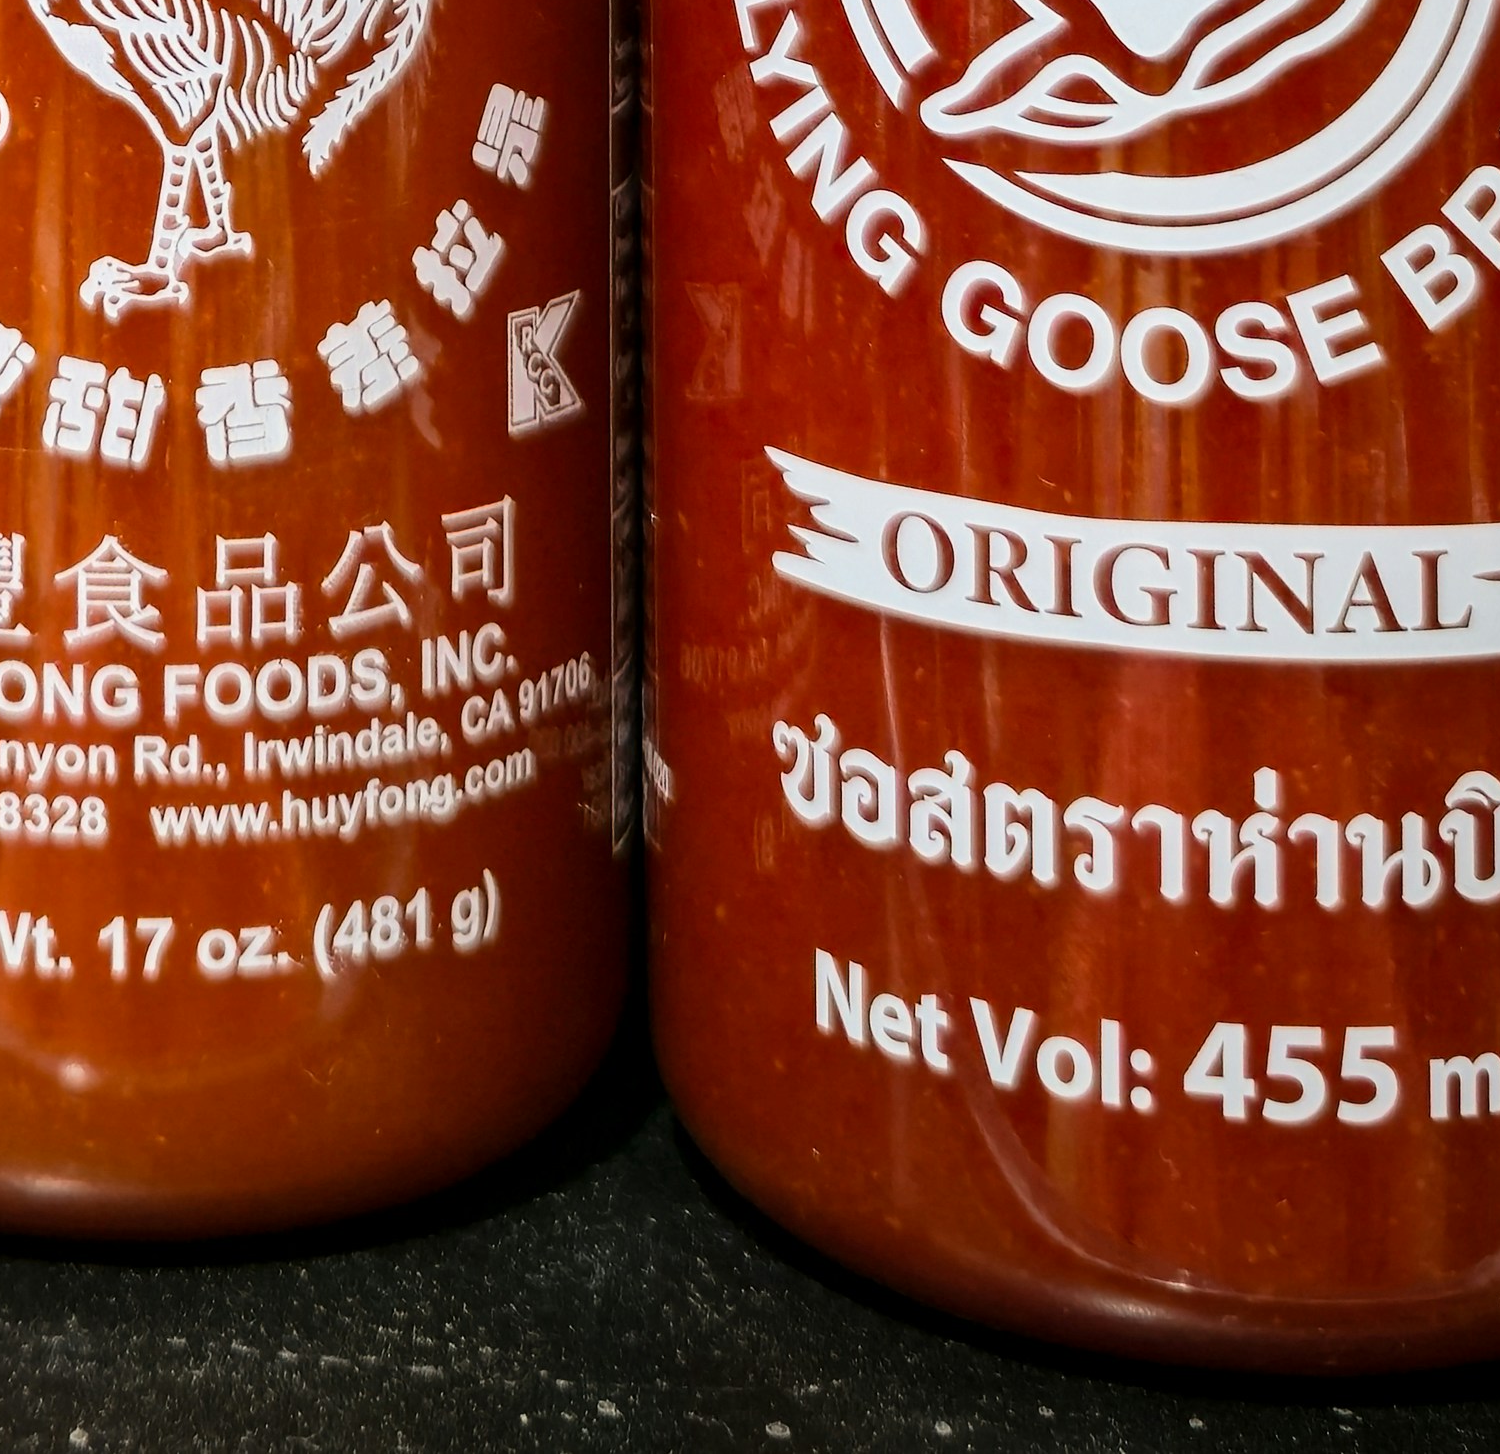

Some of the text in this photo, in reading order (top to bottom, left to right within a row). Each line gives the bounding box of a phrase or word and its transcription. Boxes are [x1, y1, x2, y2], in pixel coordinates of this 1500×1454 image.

[938, 257, 1385, 407] GOOSE
[880, 510, 1473, 635] ORIGINAL
[163, 648, 402, 725] FOODS,
[420, 623, 518, 695] INC.
[242, 712, 450, 777] Irwindale,
[460, 689, 514, 742] CA
[518, 651, 594, 726] 91706
[149, 747, 533, 845] www.huyfong.com
[98, 916, 174, 978] 17
[197, 924, 292, 976] oz.
[313, 887, 434, 979] (481
[450, 868, 500, 950] g)
[813, 948, 948, 1069] Net
[968, 998, 1153, 1110] Vol:
[1183, 1022, 1399, 1124] 455
